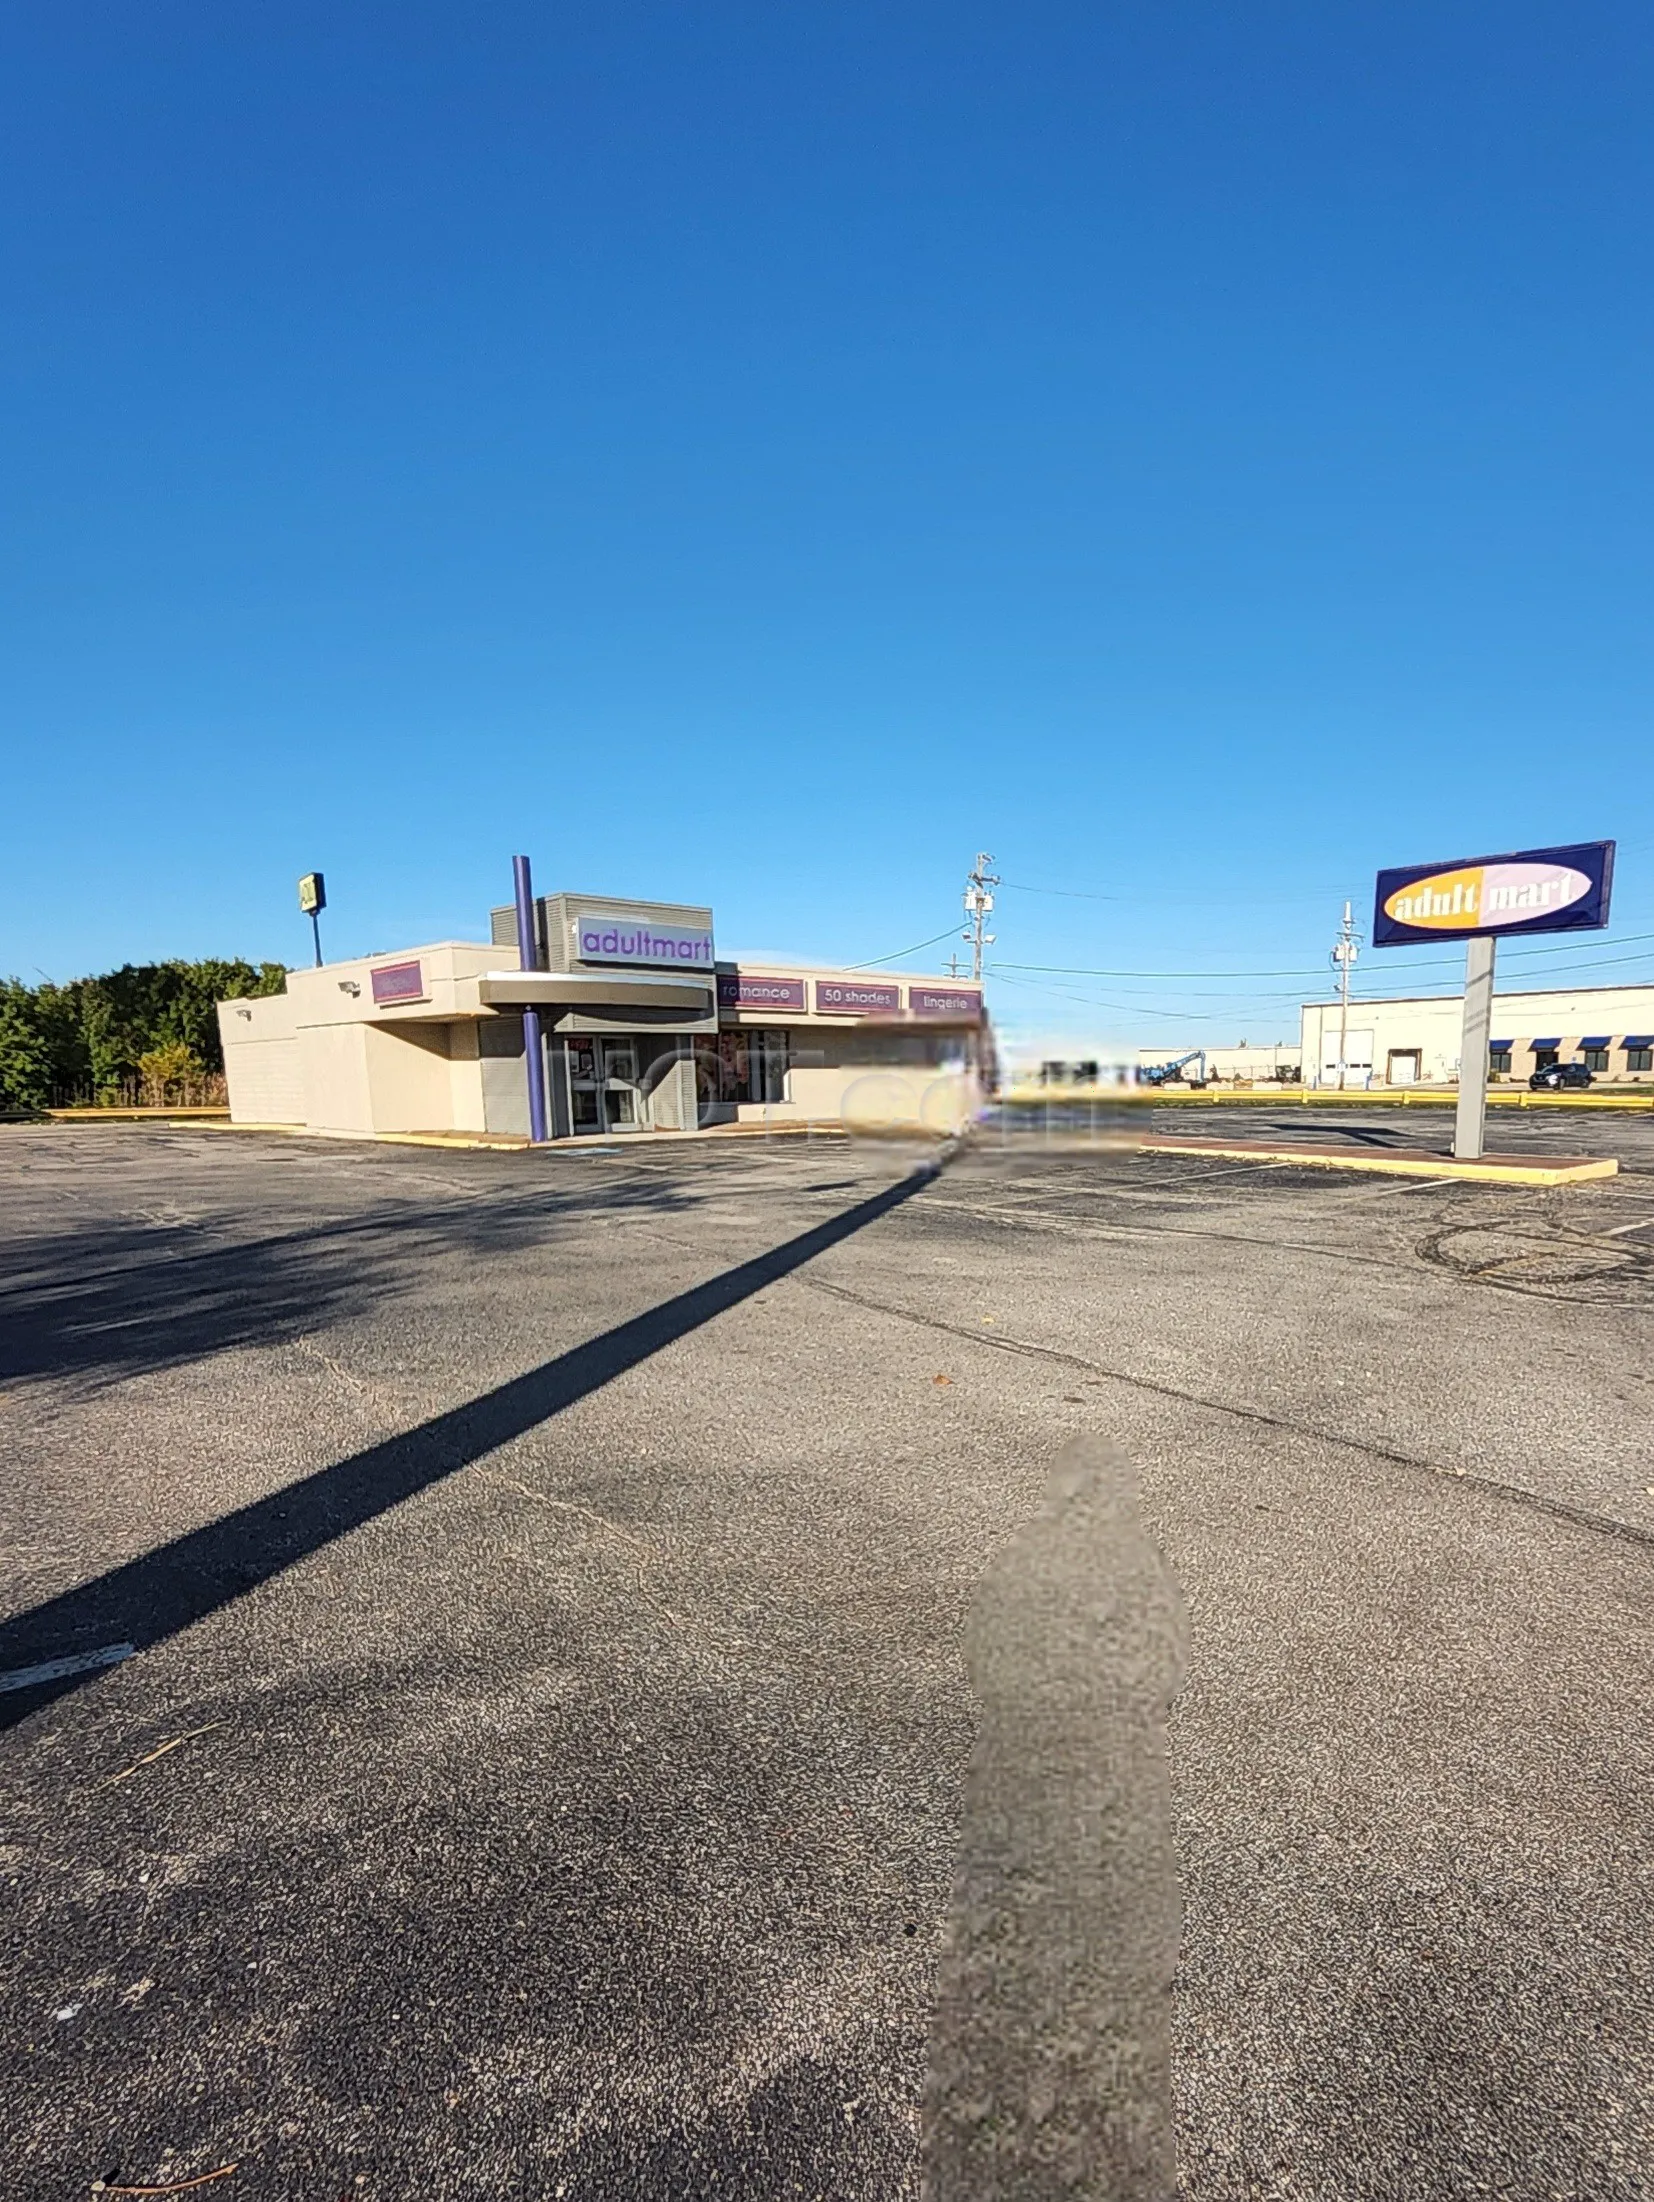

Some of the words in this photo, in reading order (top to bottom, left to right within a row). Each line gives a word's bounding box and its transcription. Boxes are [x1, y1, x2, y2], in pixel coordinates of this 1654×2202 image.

[1393, 883, 1478, 921] adult
[1487, 872, 1575, 912] mart
[582, 928, 711, 961] adultmart
[722, 986, 790, 999] romance
[824, 989, 841, 1002] 50
[844, 990, 891, 1005] shades
[923, 995, 968, 1010] lingerie
